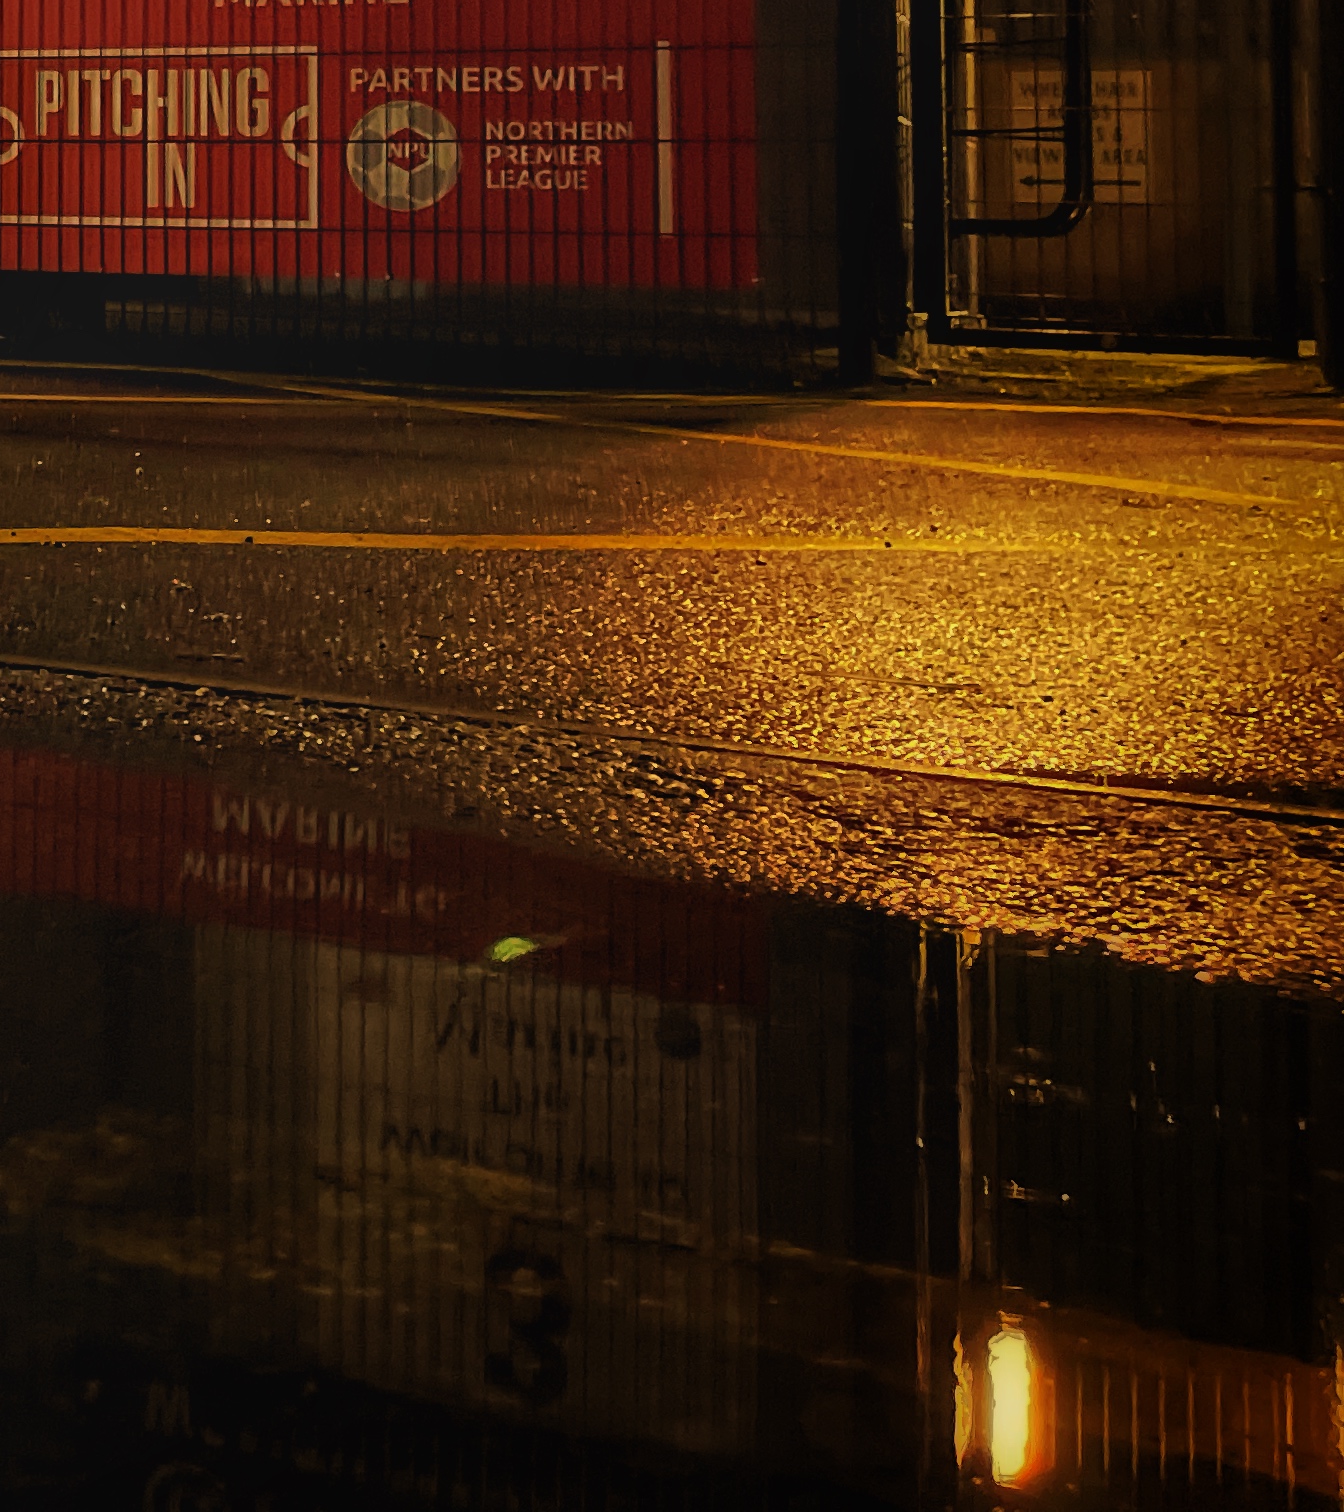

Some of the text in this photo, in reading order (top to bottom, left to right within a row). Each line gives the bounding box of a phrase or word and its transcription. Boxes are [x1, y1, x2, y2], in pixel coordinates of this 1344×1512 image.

[350, 65, 624, 94] PARTNERS WITH
[35, 68, 271, 137] PITCHING
[485, 120, 633, 141] NORTHERN
[486, 144, 602, 165] PREMIER
[148, 142, 195, 208] IN
[486, 169, 589, 190] LEAGUE
